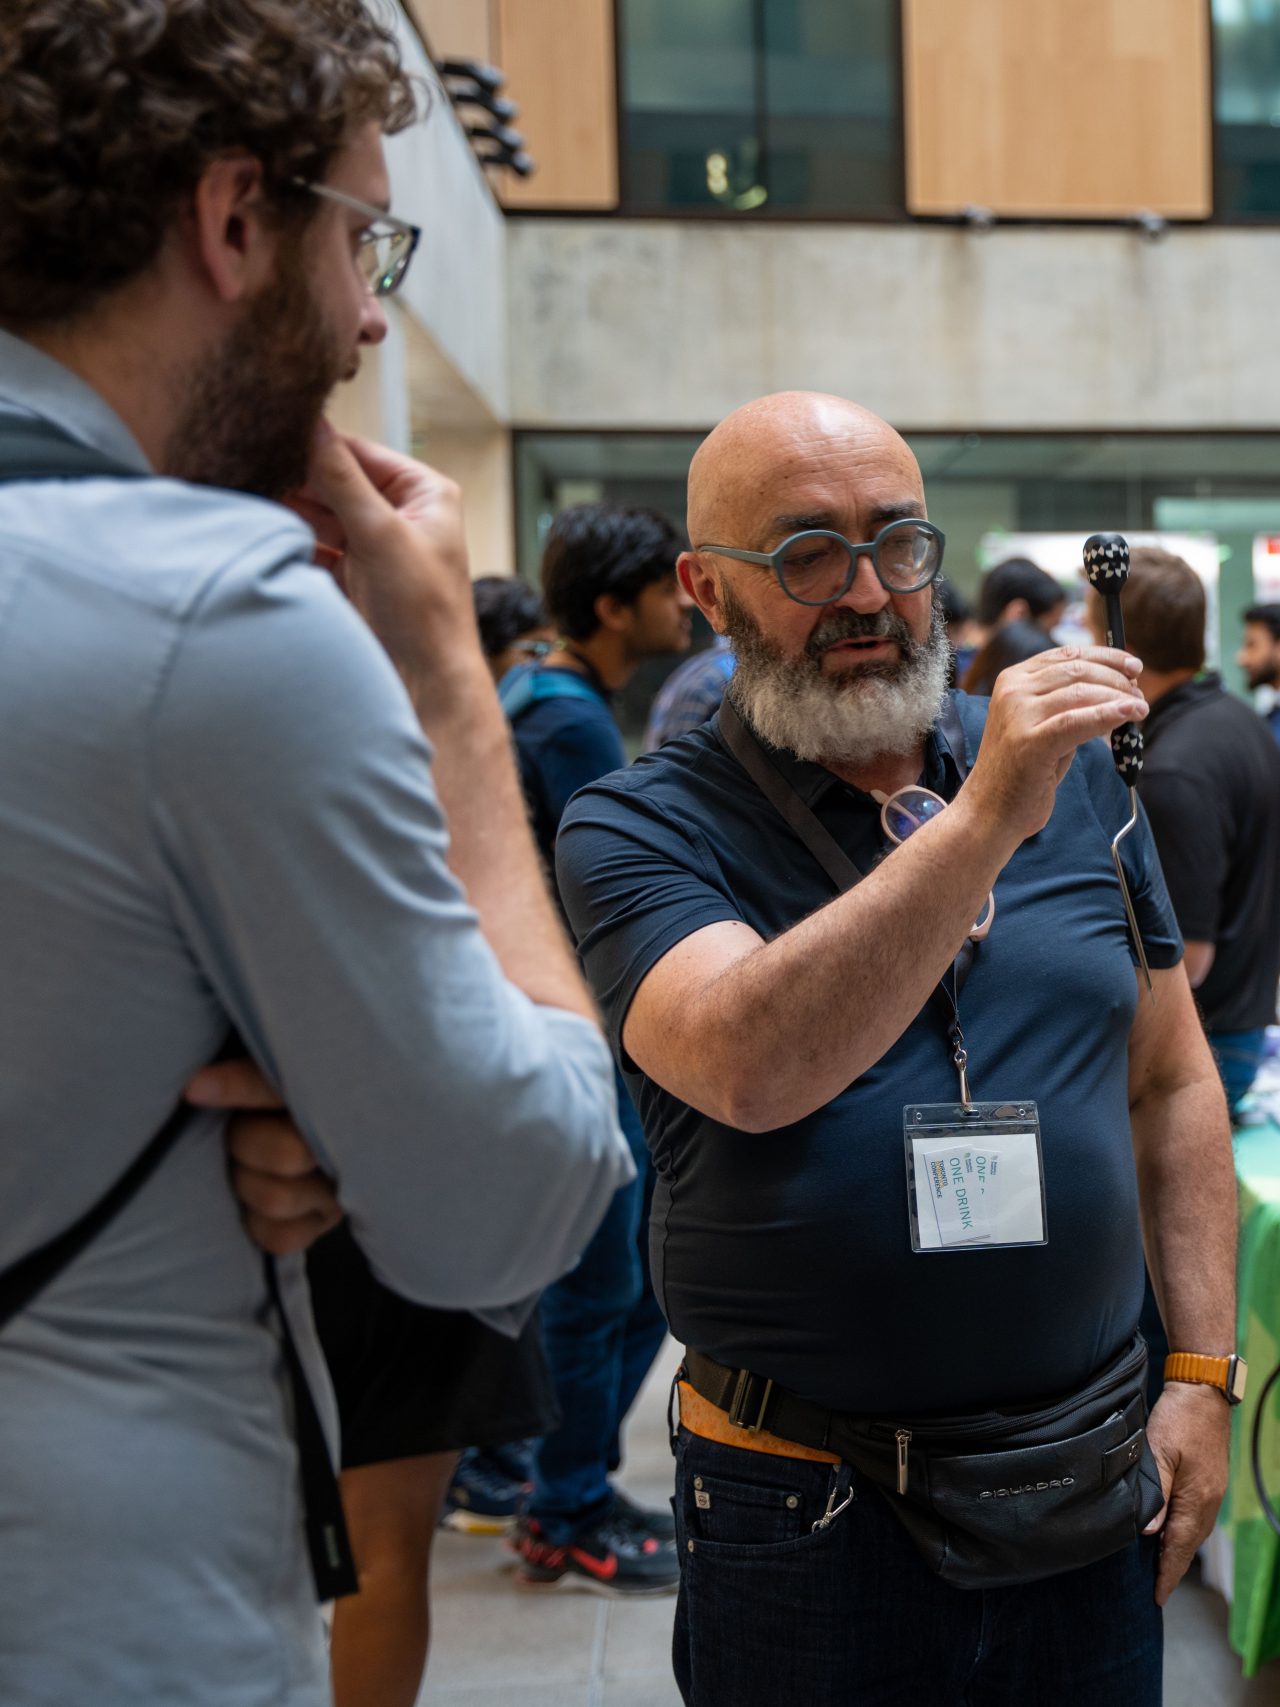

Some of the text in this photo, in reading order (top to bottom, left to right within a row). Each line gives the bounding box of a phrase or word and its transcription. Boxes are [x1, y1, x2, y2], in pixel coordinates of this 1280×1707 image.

[950, 1157, 965, 1185] ONE
[956, 1189, 974, 1230] DRINK
[979, 1477, 1074, 1500] PIQUADRO
